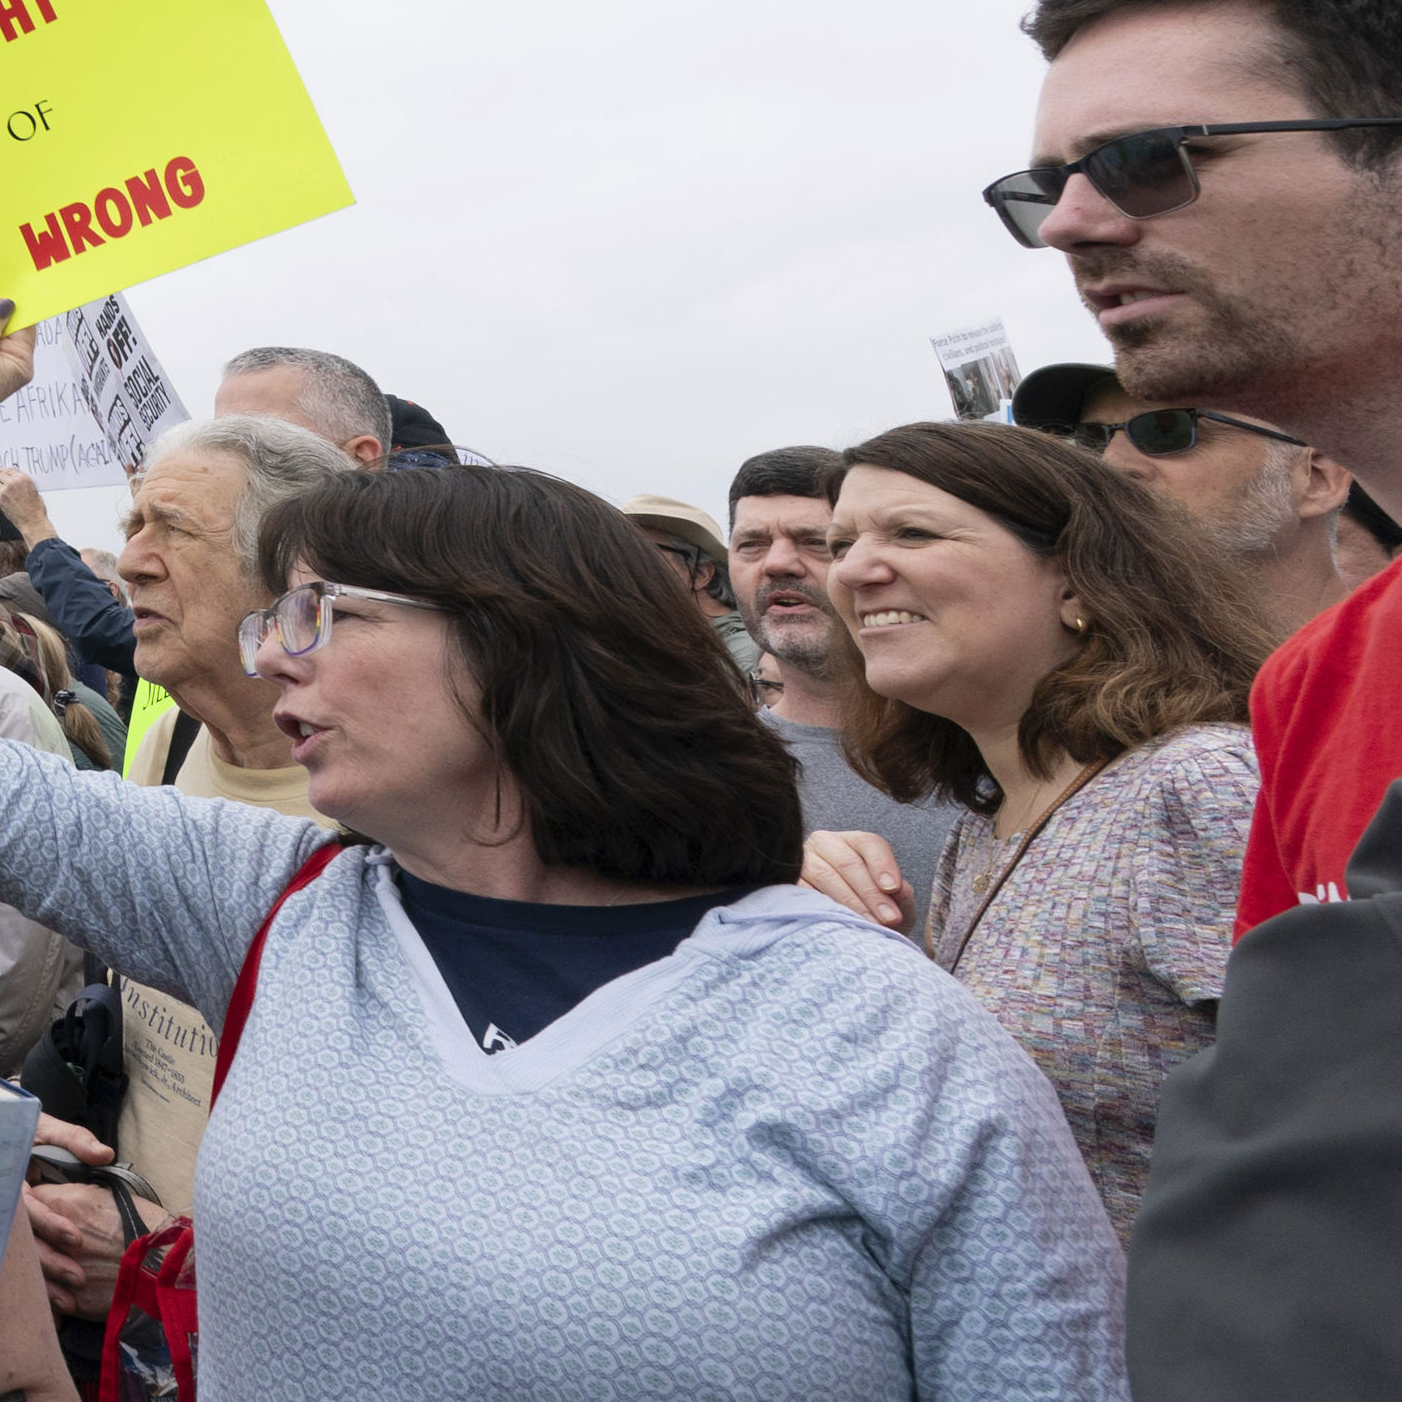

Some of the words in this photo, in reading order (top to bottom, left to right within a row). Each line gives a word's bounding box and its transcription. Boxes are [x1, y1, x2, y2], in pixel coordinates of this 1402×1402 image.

[7, 100, 54, 141] OF
[19, 156, 205, 272] WRONG
[95, 293, 121, 340] HANDS
[124, 355, 160, 411] SOCIAL
[139, 382, 171, 432] SECURITY
